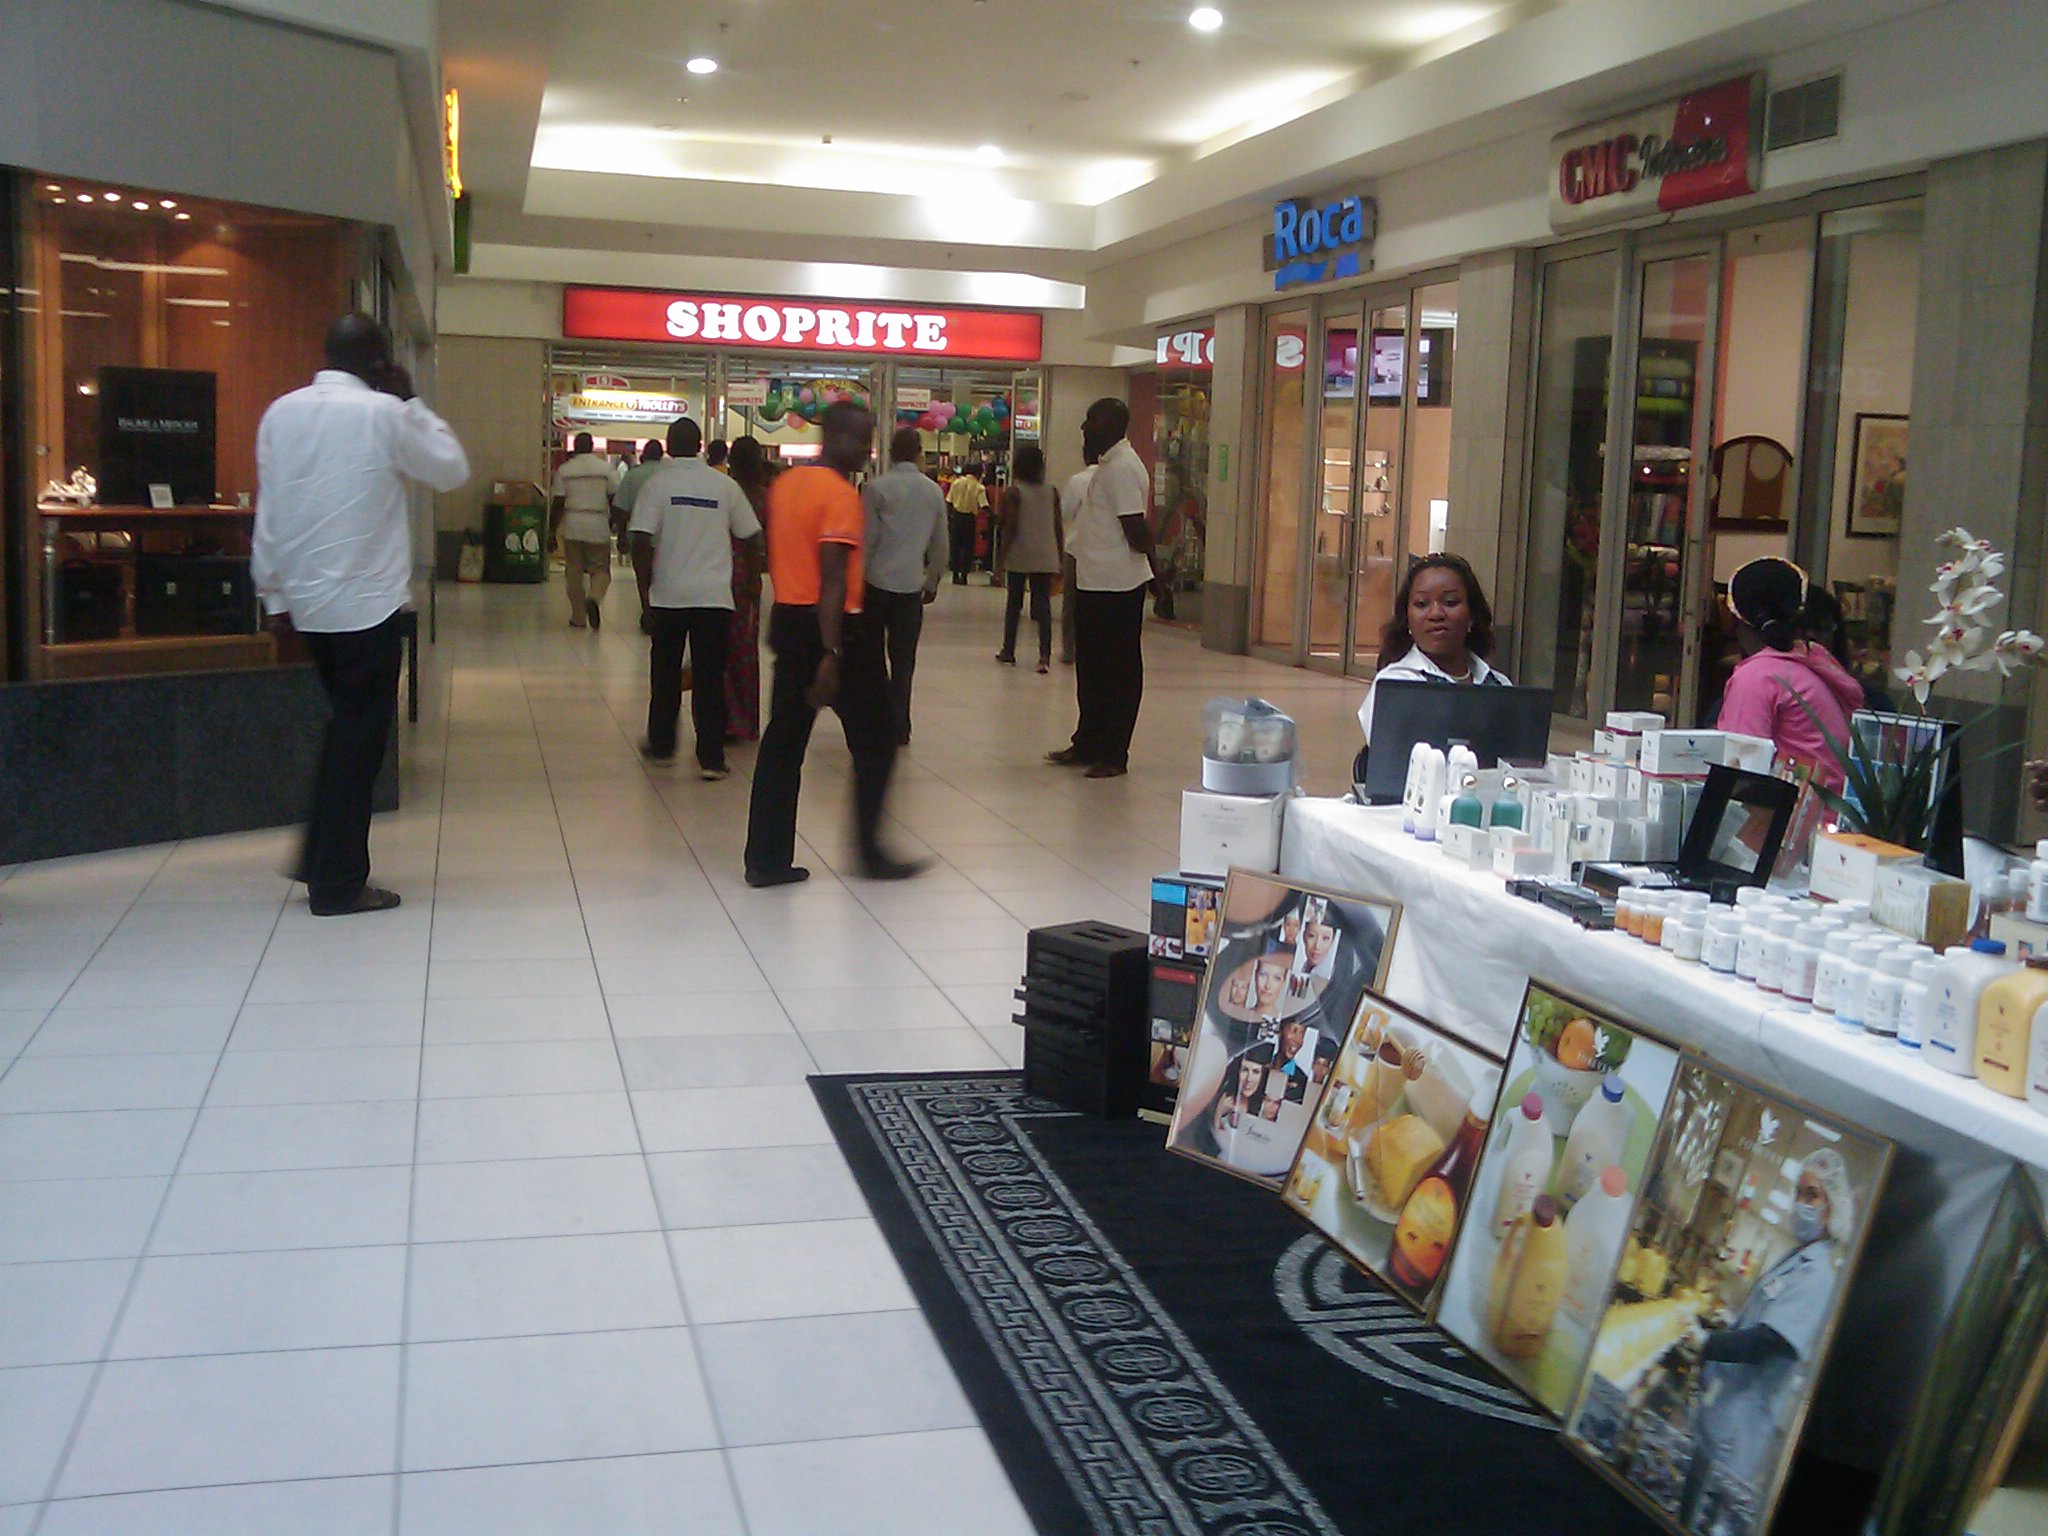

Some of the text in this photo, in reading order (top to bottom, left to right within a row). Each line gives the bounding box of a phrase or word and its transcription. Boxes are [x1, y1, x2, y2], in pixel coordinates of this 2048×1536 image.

[1560, 134, 1640, 204] CMC
[1274, 195, 1363, 260] Roca
[666, 300, 948, 351] SHOPRITE
